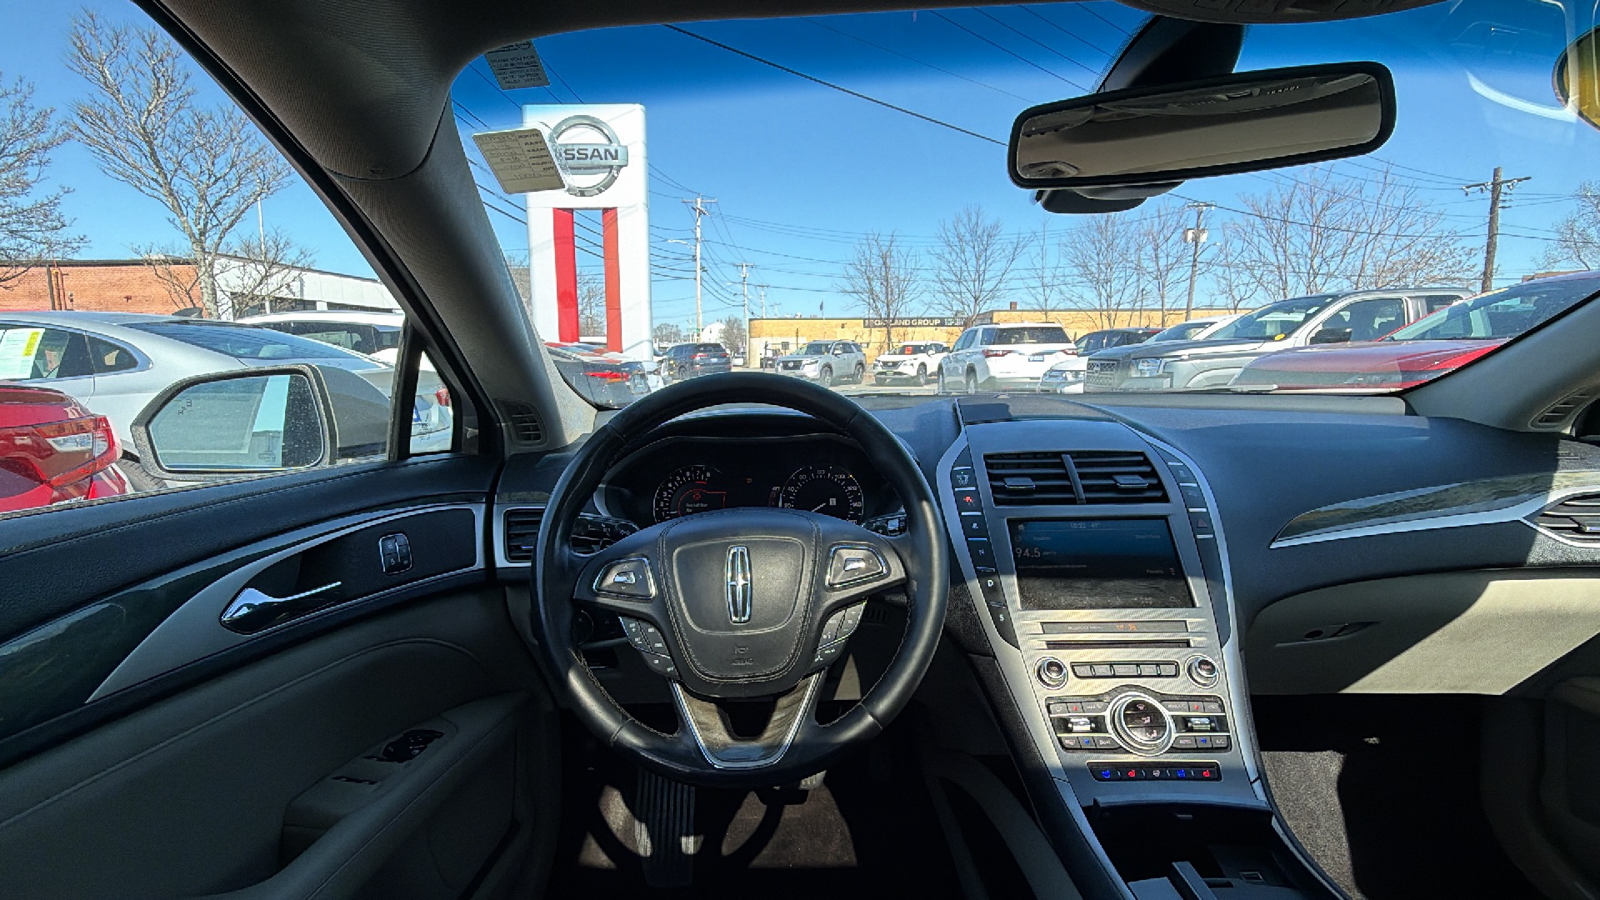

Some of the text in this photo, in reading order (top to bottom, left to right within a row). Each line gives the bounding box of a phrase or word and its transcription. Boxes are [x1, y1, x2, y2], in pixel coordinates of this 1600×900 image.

[559, 147, 619, 161] SSAN
[911, 318, 941, 326] GROUP
[1015, 547, 1041, 558] 94.5
